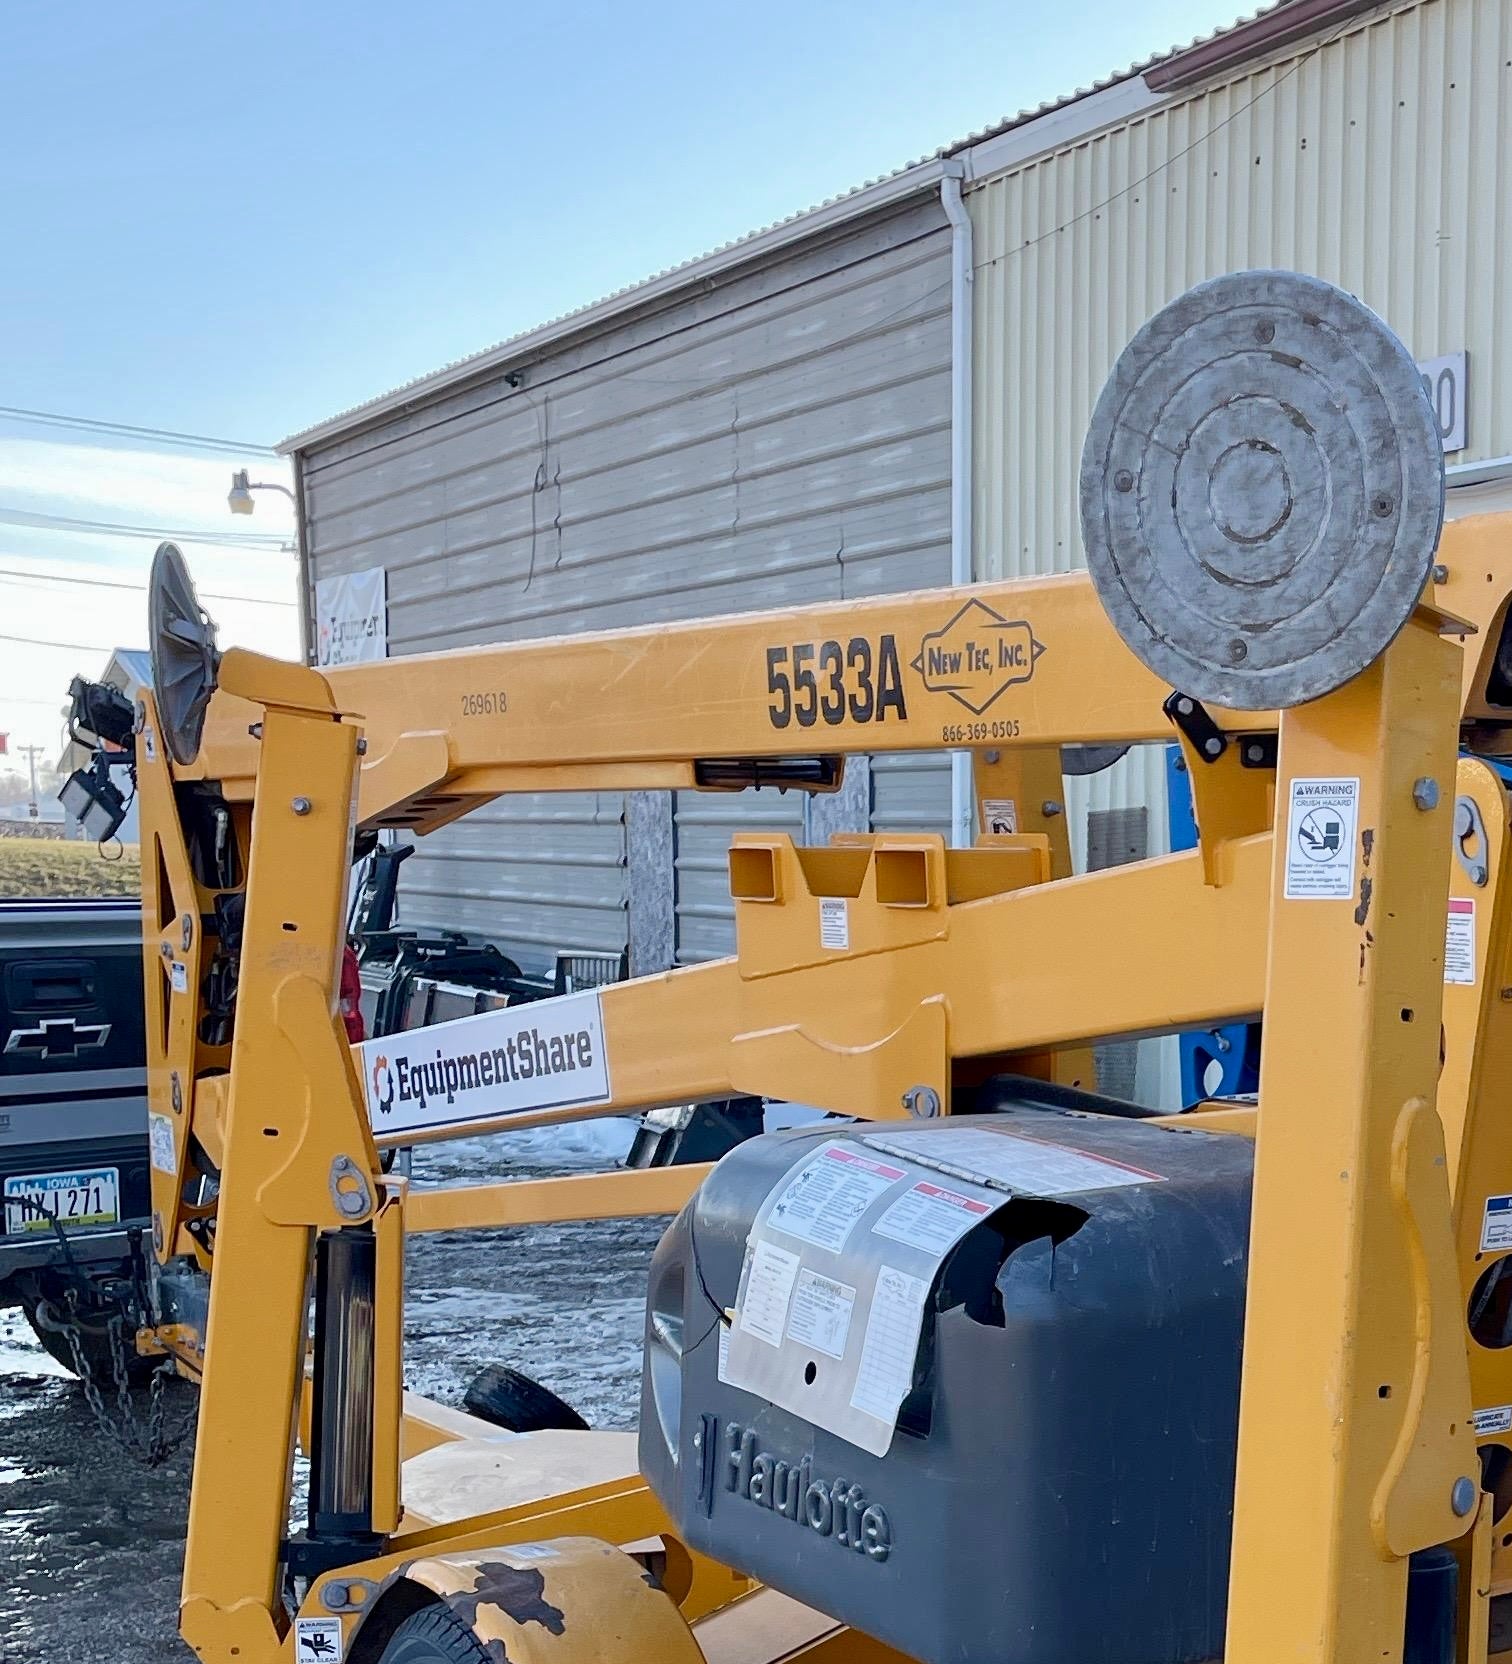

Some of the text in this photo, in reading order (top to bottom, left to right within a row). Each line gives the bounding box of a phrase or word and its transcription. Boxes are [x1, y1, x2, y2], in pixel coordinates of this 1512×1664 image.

[766, 634, 908, 729] 5533A
[461, 692, 507, 716] 269618
[942, 719, 1020, 743] 866-369-0505
[1304, 785, 1353, 795] WARNING
[395, 1028, 593, 1109] EquipmentShare
[46, 1177, 79, 1190] IOWA
[67, 1186, 103, 1217] 271
[725, 1421, 893, 1563] Haulotte
